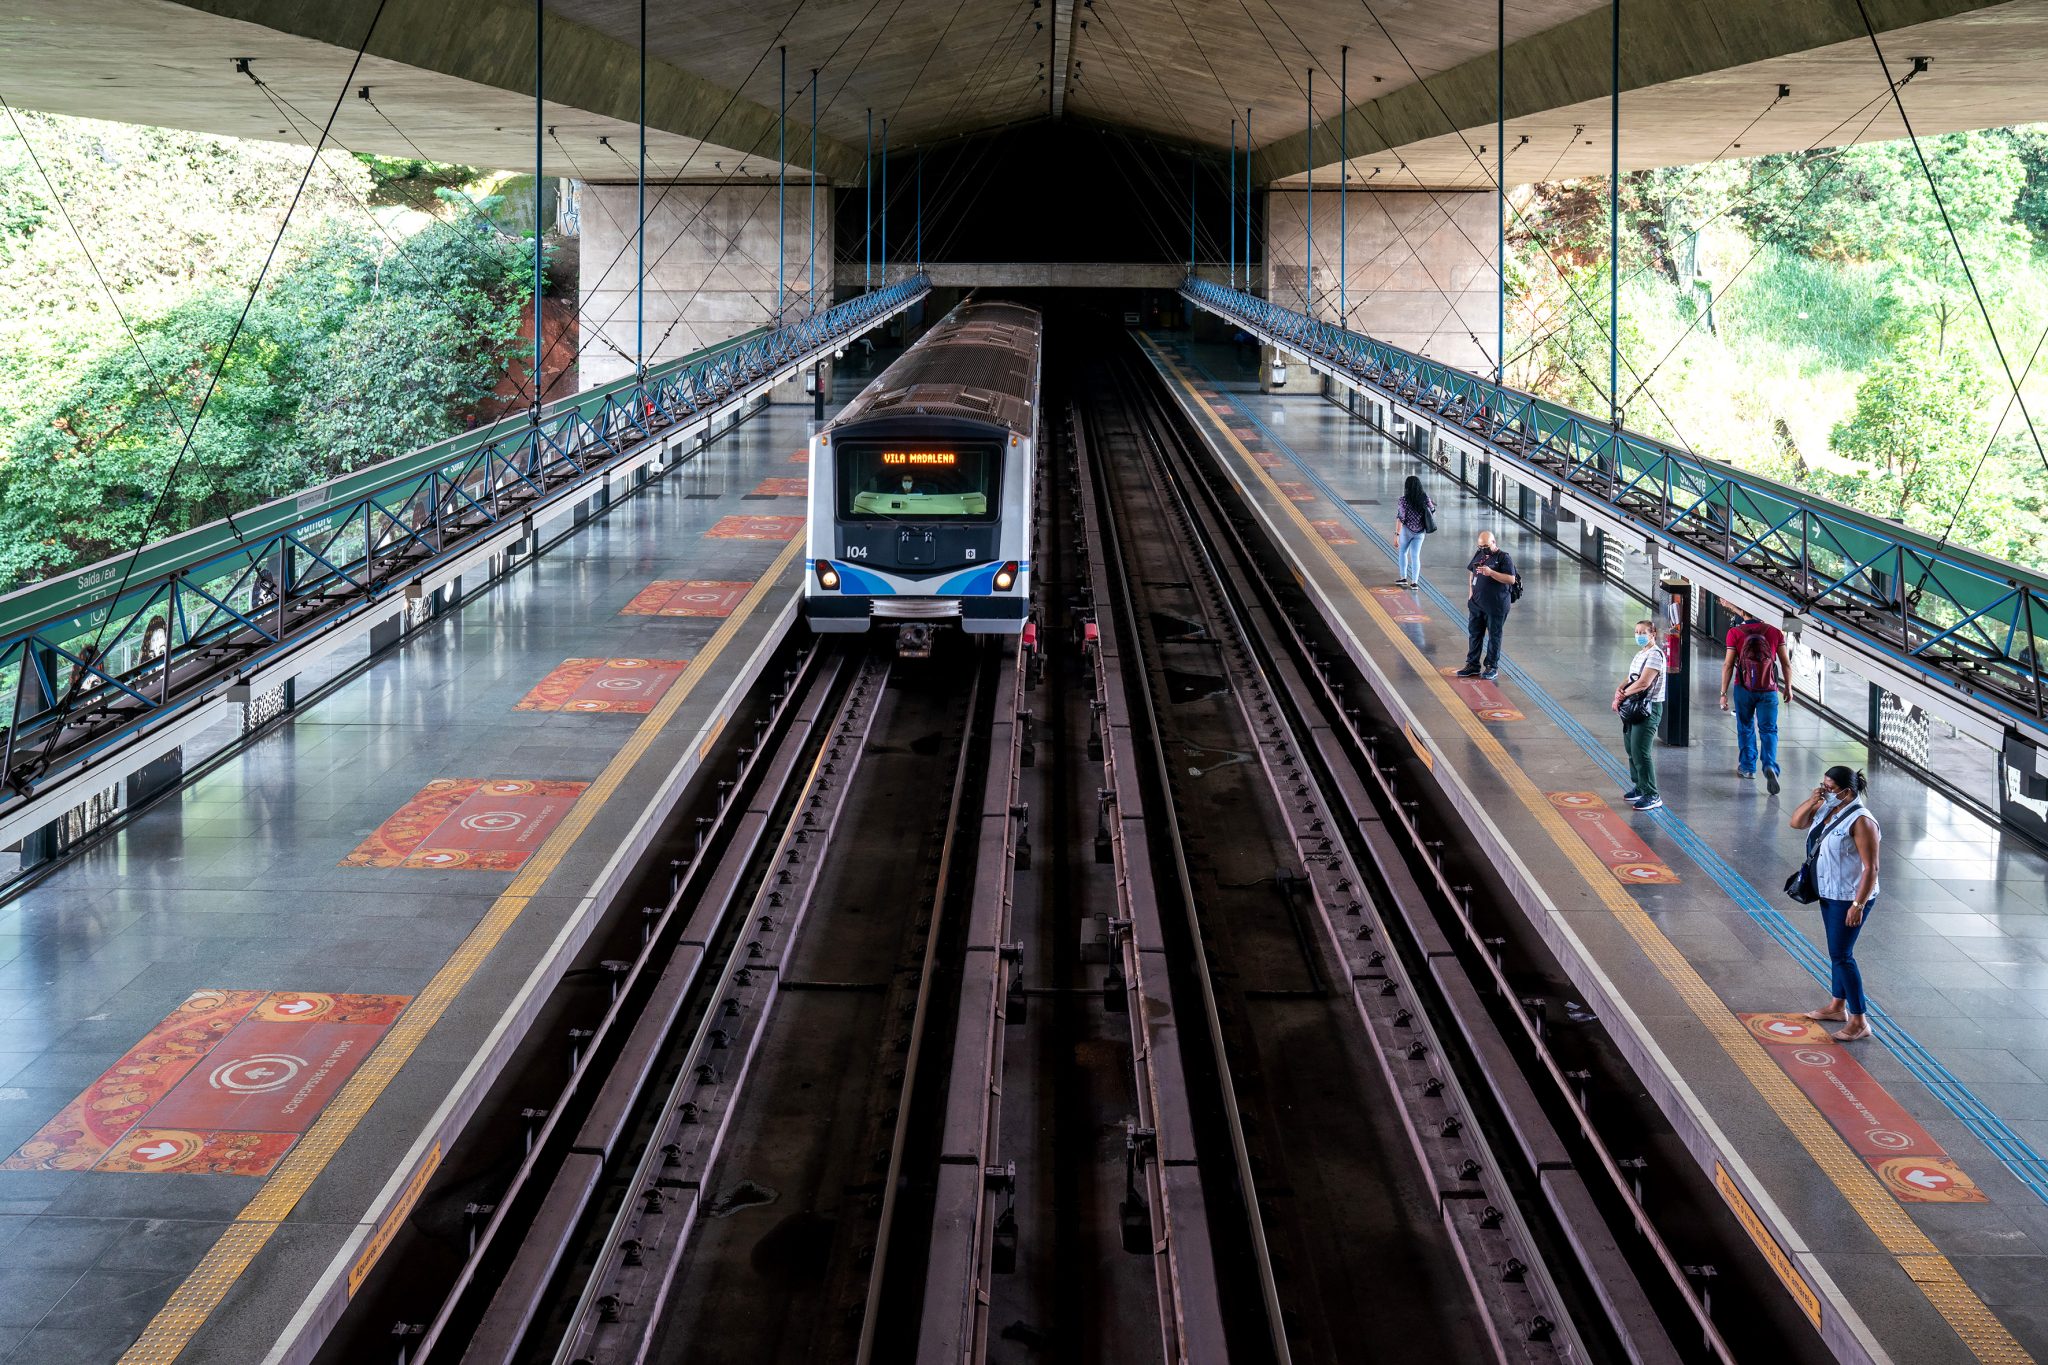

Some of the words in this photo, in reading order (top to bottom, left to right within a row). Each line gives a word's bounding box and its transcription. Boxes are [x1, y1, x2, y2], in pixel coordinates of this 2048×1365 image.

[884, 453, 905, 464] VILA
[910, 453, 955, 464] MADALENA
[846, 546, 868, 559] 104
[281, 1067, 330, 1114] PASSAGEIROS
